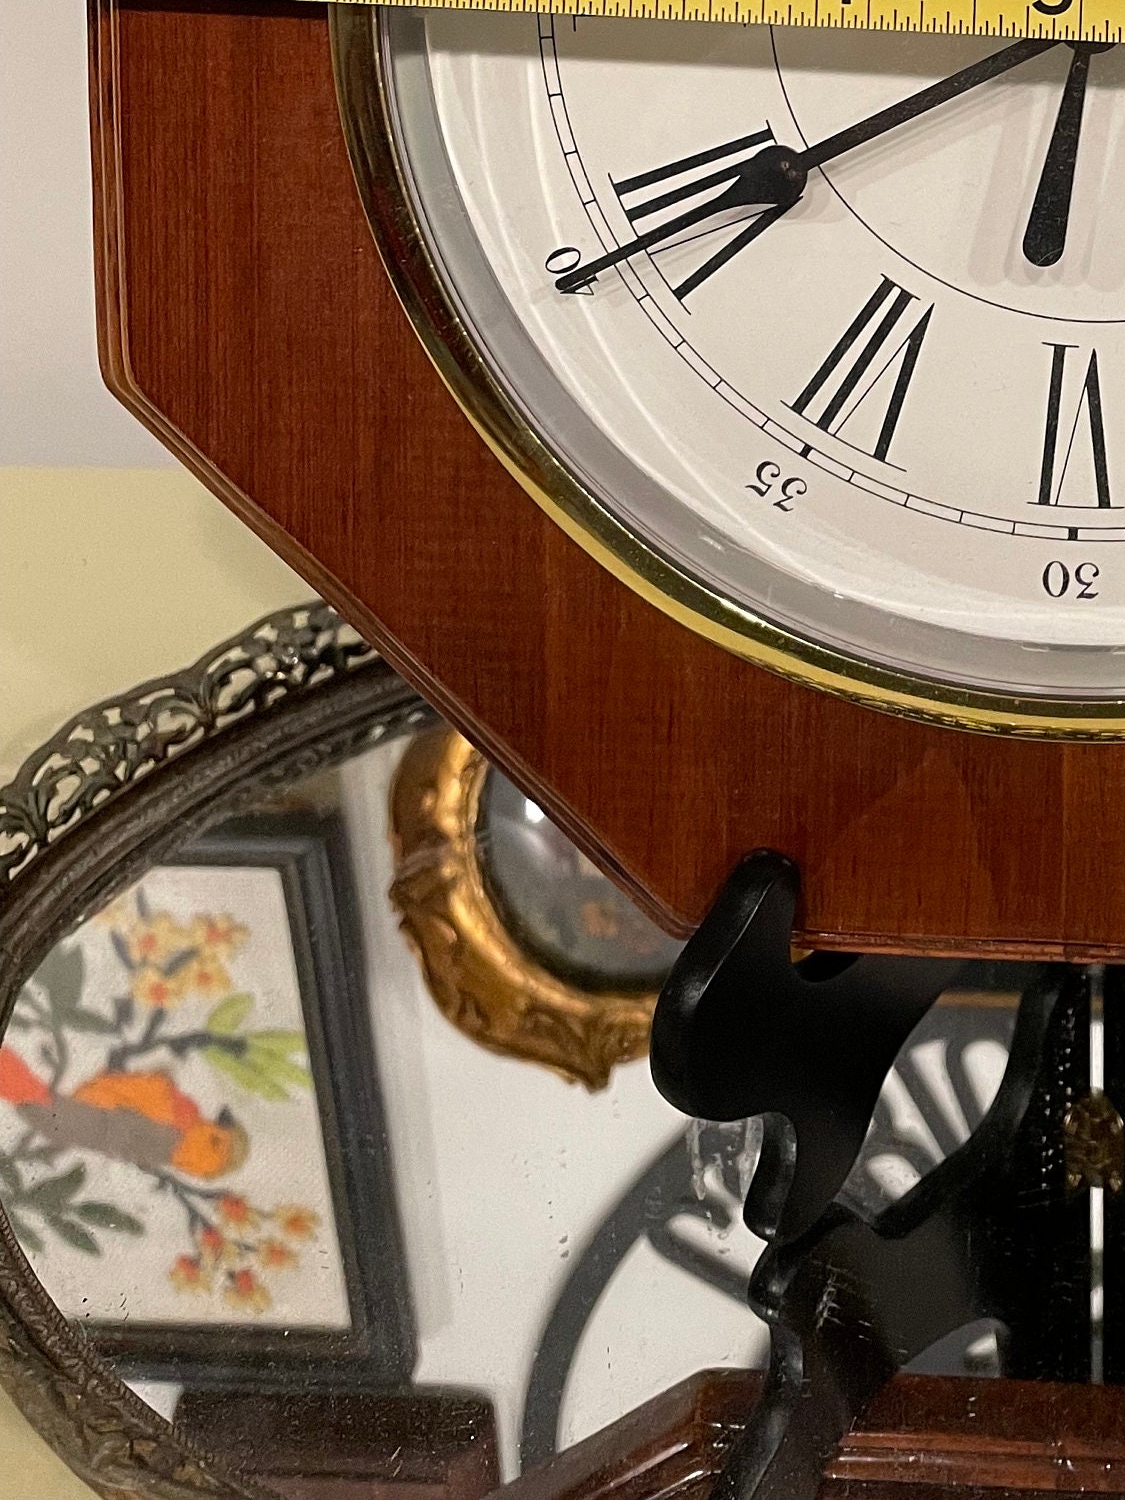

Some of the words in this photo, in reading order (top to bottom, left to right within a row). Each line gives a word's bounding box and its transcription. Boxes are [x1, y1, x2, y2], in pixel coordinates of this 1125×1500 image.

[780, 273, 935, 472] VII
[1026, 341, 1125, 509] VI
[744, 459, 808, 513] 35
[1041, 560, 1100, 600] 30
